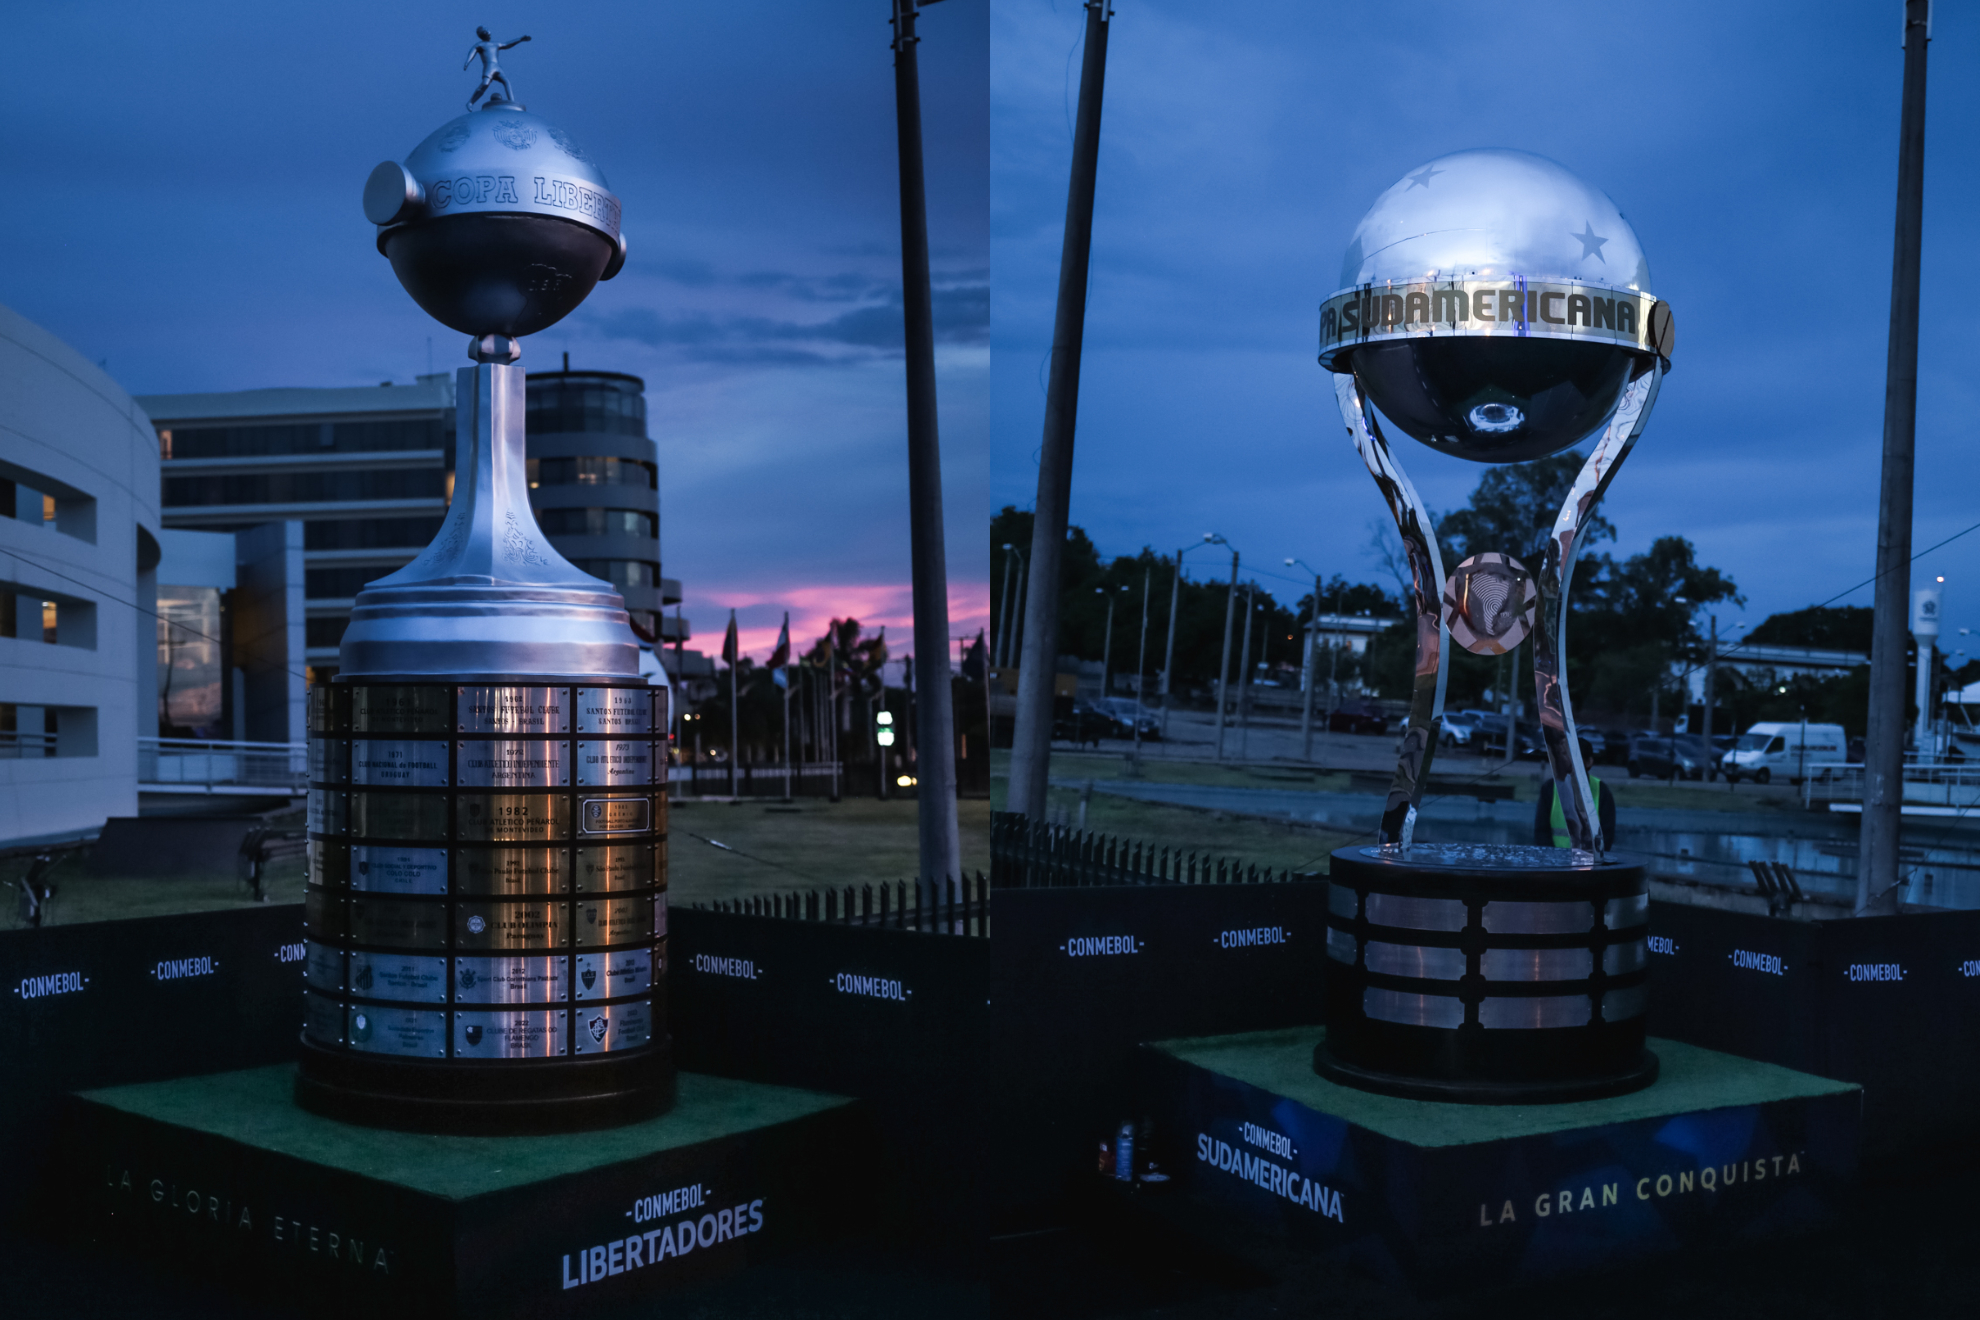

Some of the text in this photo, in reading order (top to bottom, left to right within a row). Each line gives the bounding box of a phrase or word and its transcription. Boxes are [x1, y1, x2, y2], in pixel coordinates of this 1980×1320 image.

[432, 175, 518, 209] COPA
[1341, 289, 1636, 334] SUDAMERICANA
[498, 807, 529, 816] 1982
[526, 817, 559, 825] PEÑAROL
[514, 911, 540, 919] 2002
[1197, 1132, 1344, 1224] SUDAMERICANA
[1480, 1152, 1801, 1227] LA GRAN CONQUISTA
[107, 1164, 389, 1275] LA GLORIA ETERNA
[562, 1198, 764, 1290] LIBERTADORES
